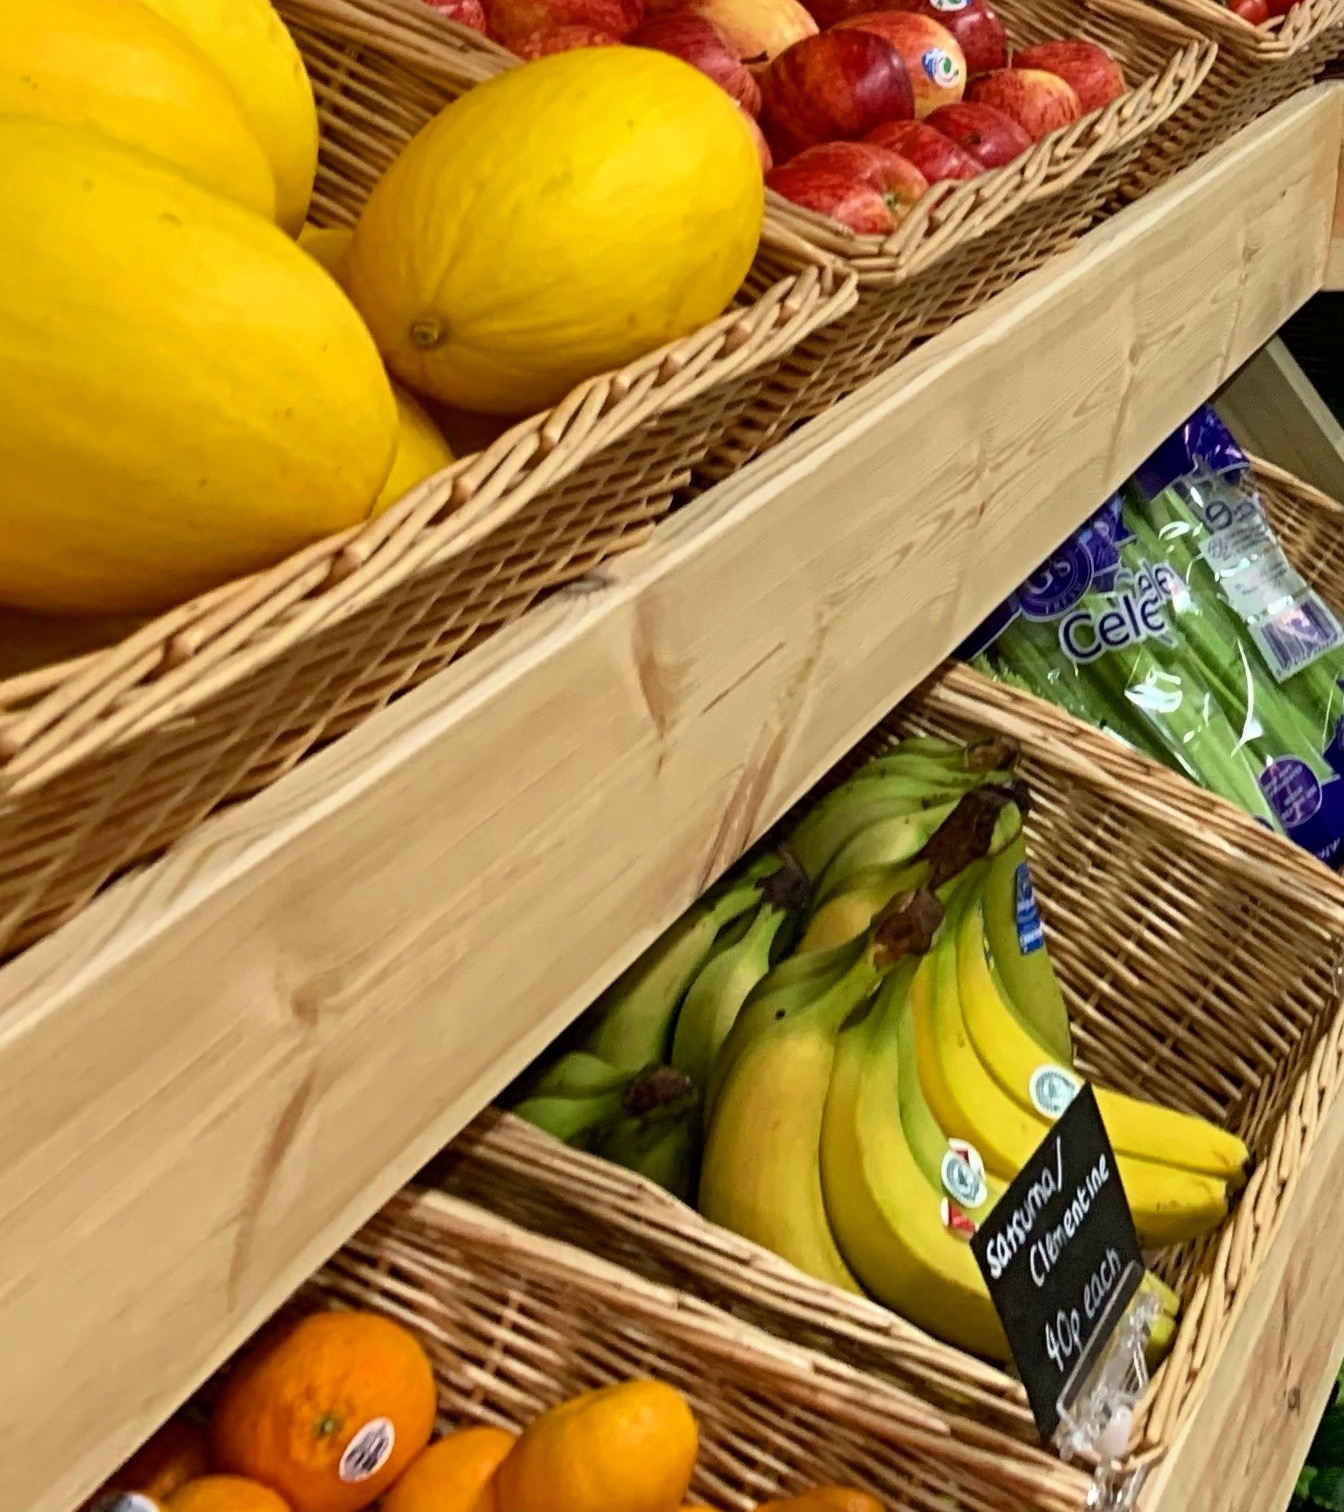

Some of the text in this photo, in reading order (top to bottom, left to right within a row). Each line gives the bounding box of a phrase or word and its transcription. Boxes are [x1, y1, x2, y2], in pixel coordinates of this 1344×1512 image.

[1029, 1153, 1110, 1288] Clementine
[1044, 1246, 1122, 1373] 40p each
